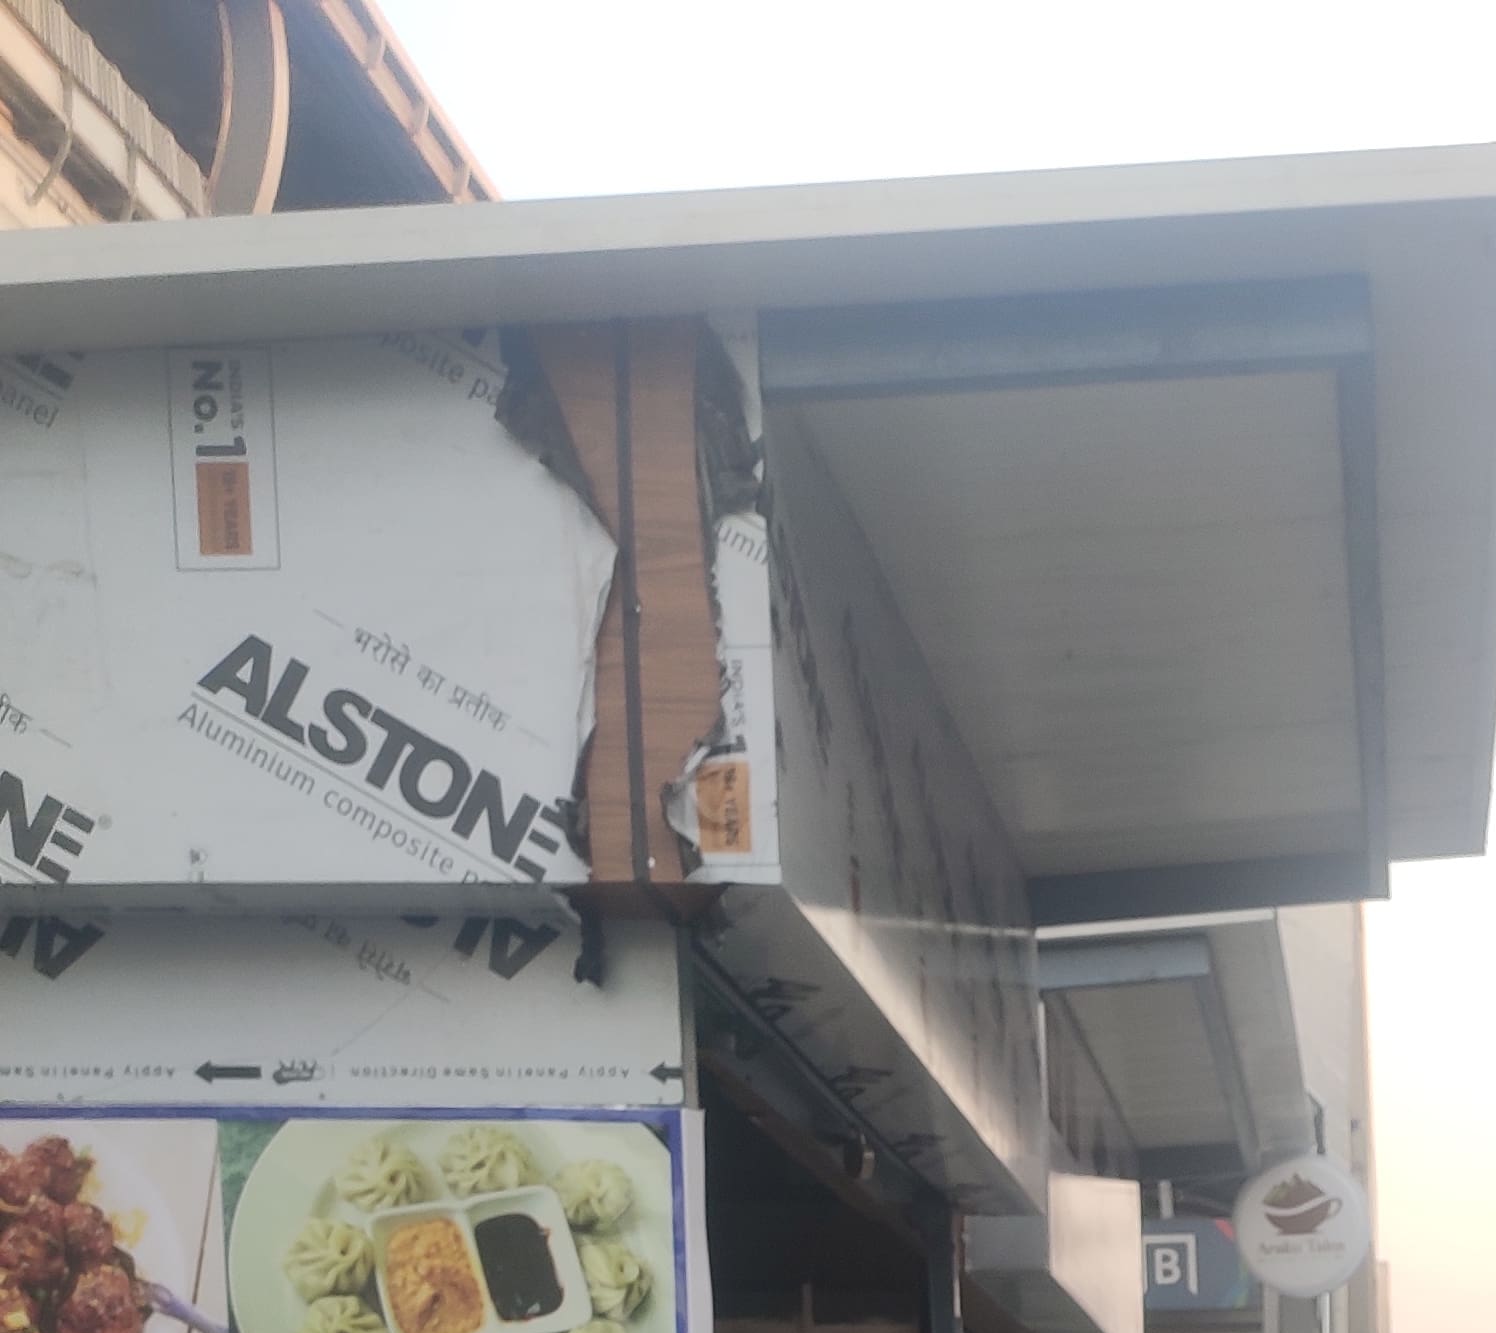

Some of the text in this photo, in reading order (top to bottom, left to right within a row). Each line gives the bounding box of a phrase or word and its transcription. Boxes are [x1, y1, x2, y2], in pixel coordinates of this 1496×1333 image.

[177, 702, 455, 876] Aluminium composite
[197, 634, 570, 884] ALSTONE
[1155, 1248, 1182, 1285] B
